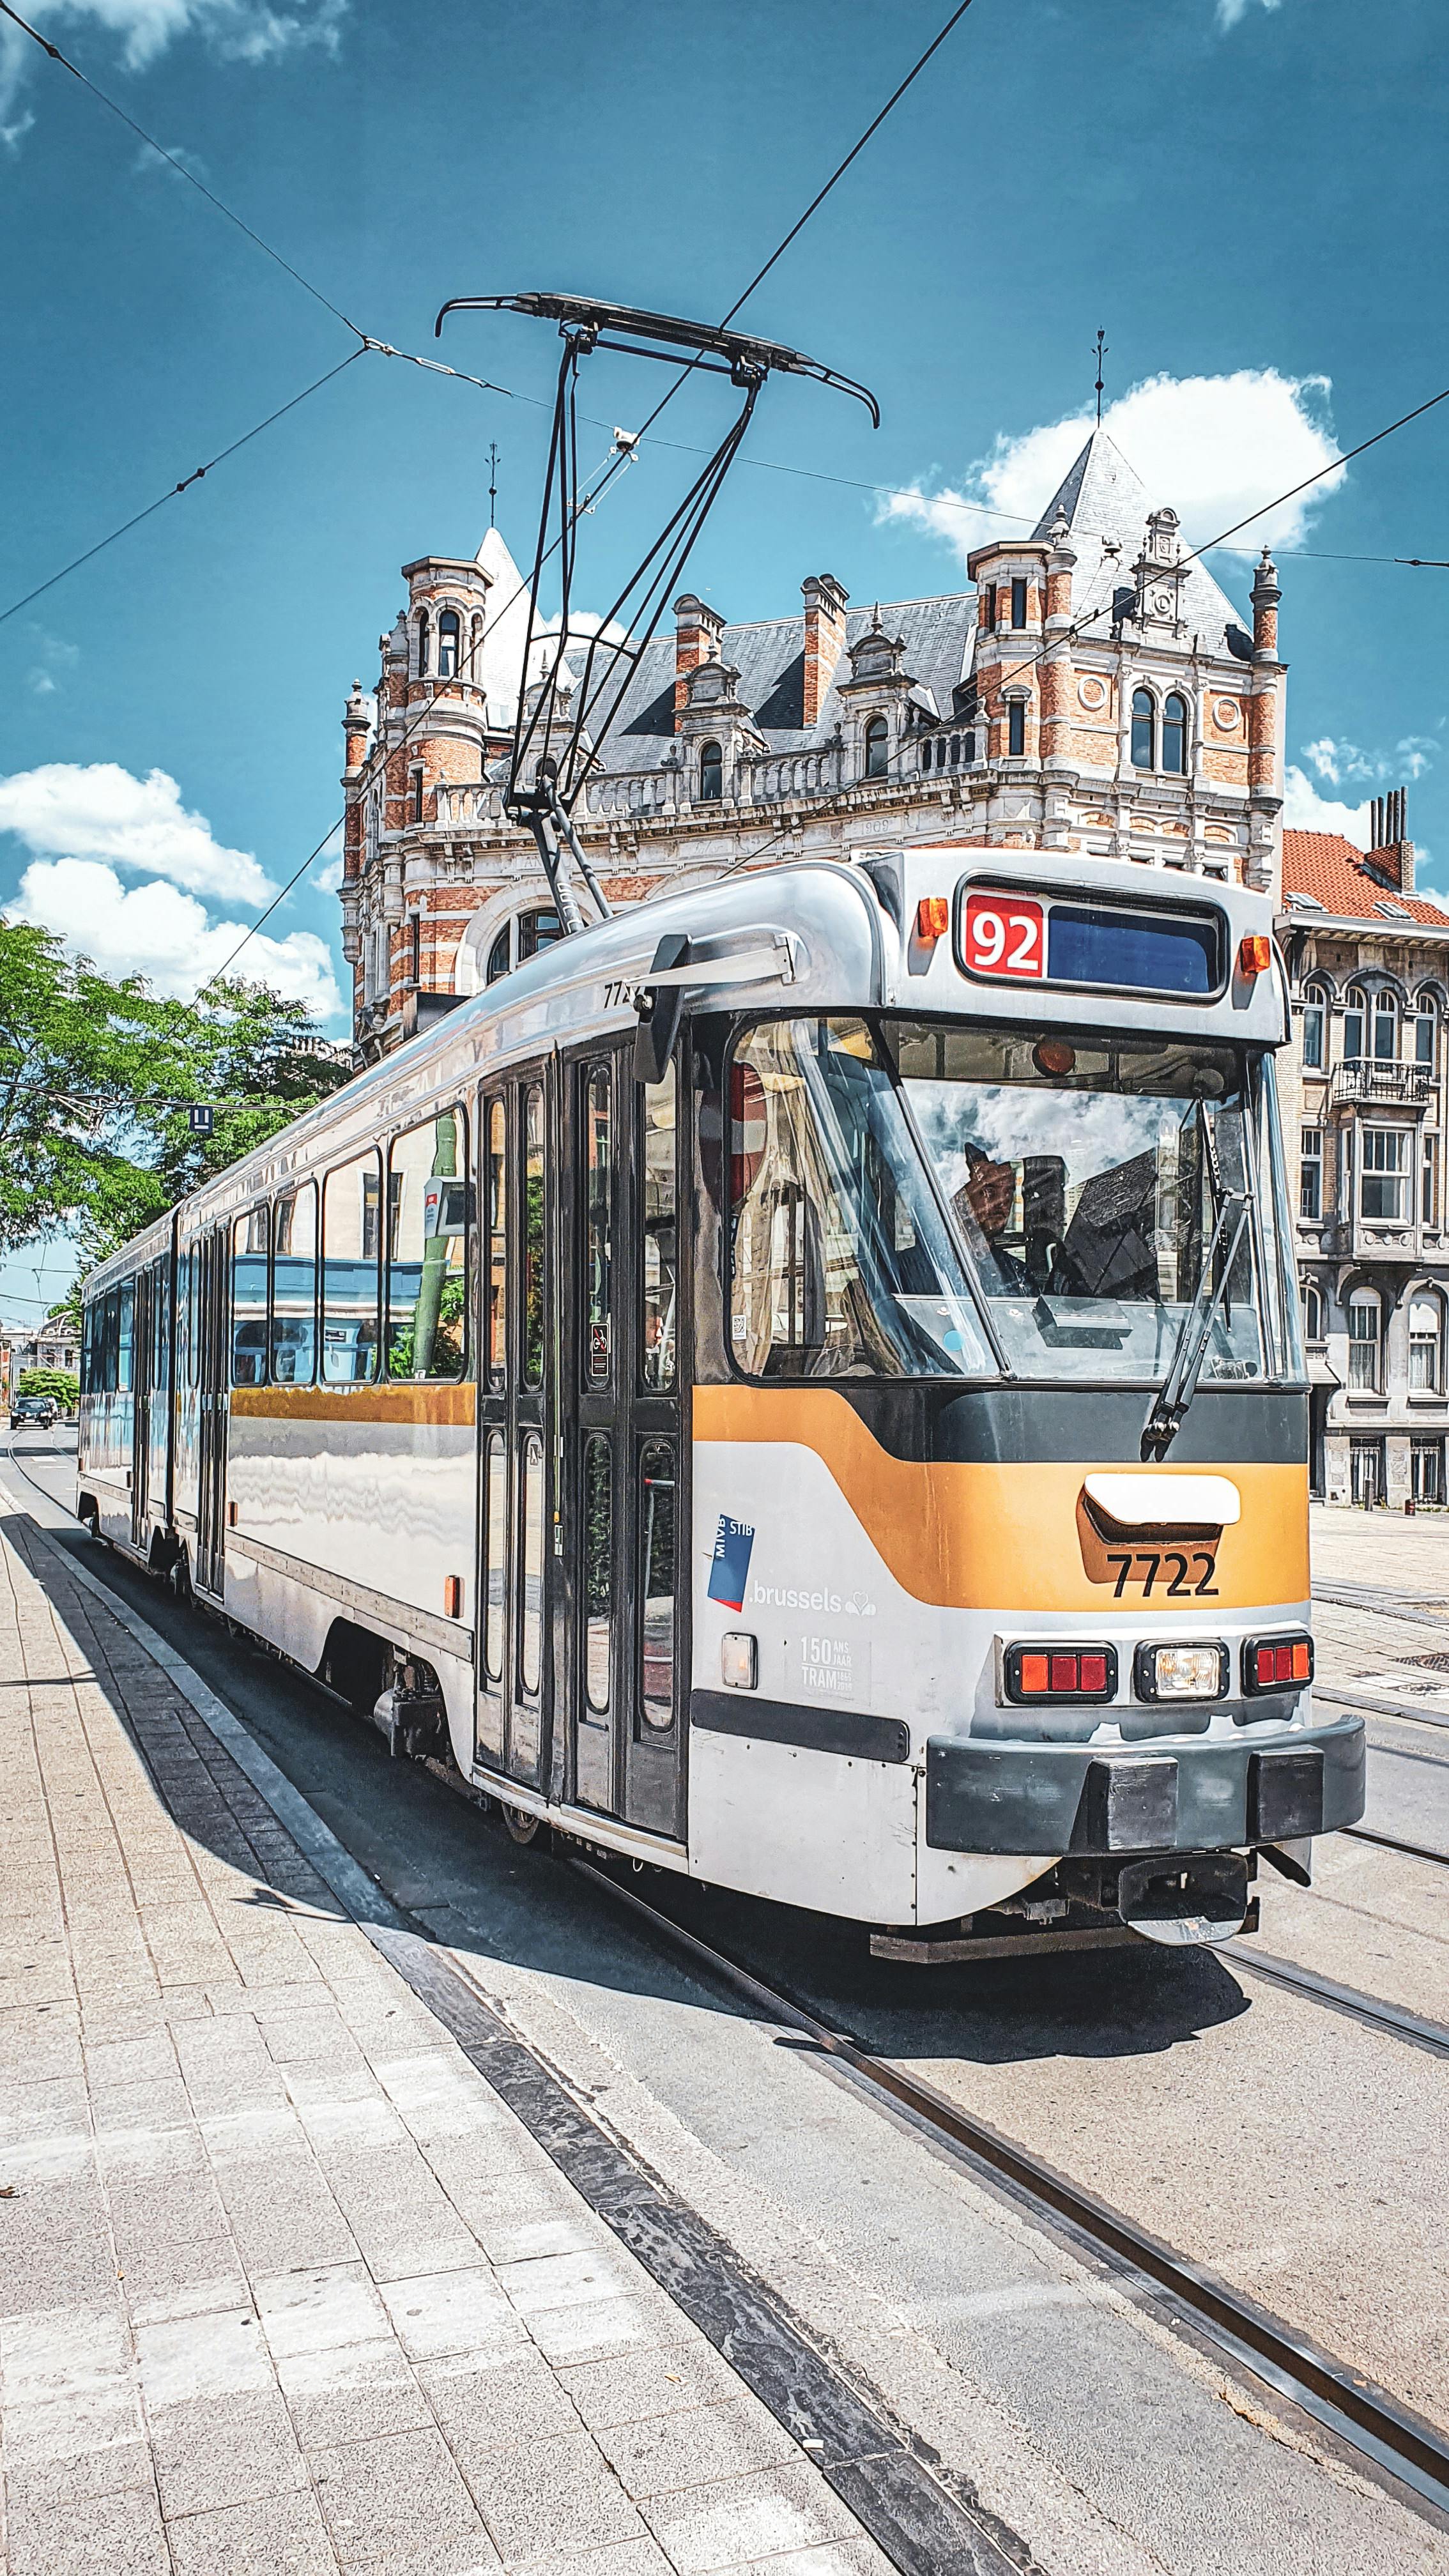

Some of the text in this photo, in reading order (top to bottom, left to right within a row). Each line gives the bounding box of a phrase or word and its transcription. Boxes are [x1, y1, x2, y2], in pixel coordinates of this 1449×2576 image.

[972, 911, 1039, 970] 92
[716, 1517, 726, 1558] MIVB
[730, 1521, 753, 1537] STIB
[1107, 1552, 1219, 1598] 7722
[749, 1581, 841, 1613] .brussels
[801, 1636, 849, 1665] 150 ANS
[832, 1654, 852, 1667] JAAR
[802, 1666, 837, 1690] TRAM
